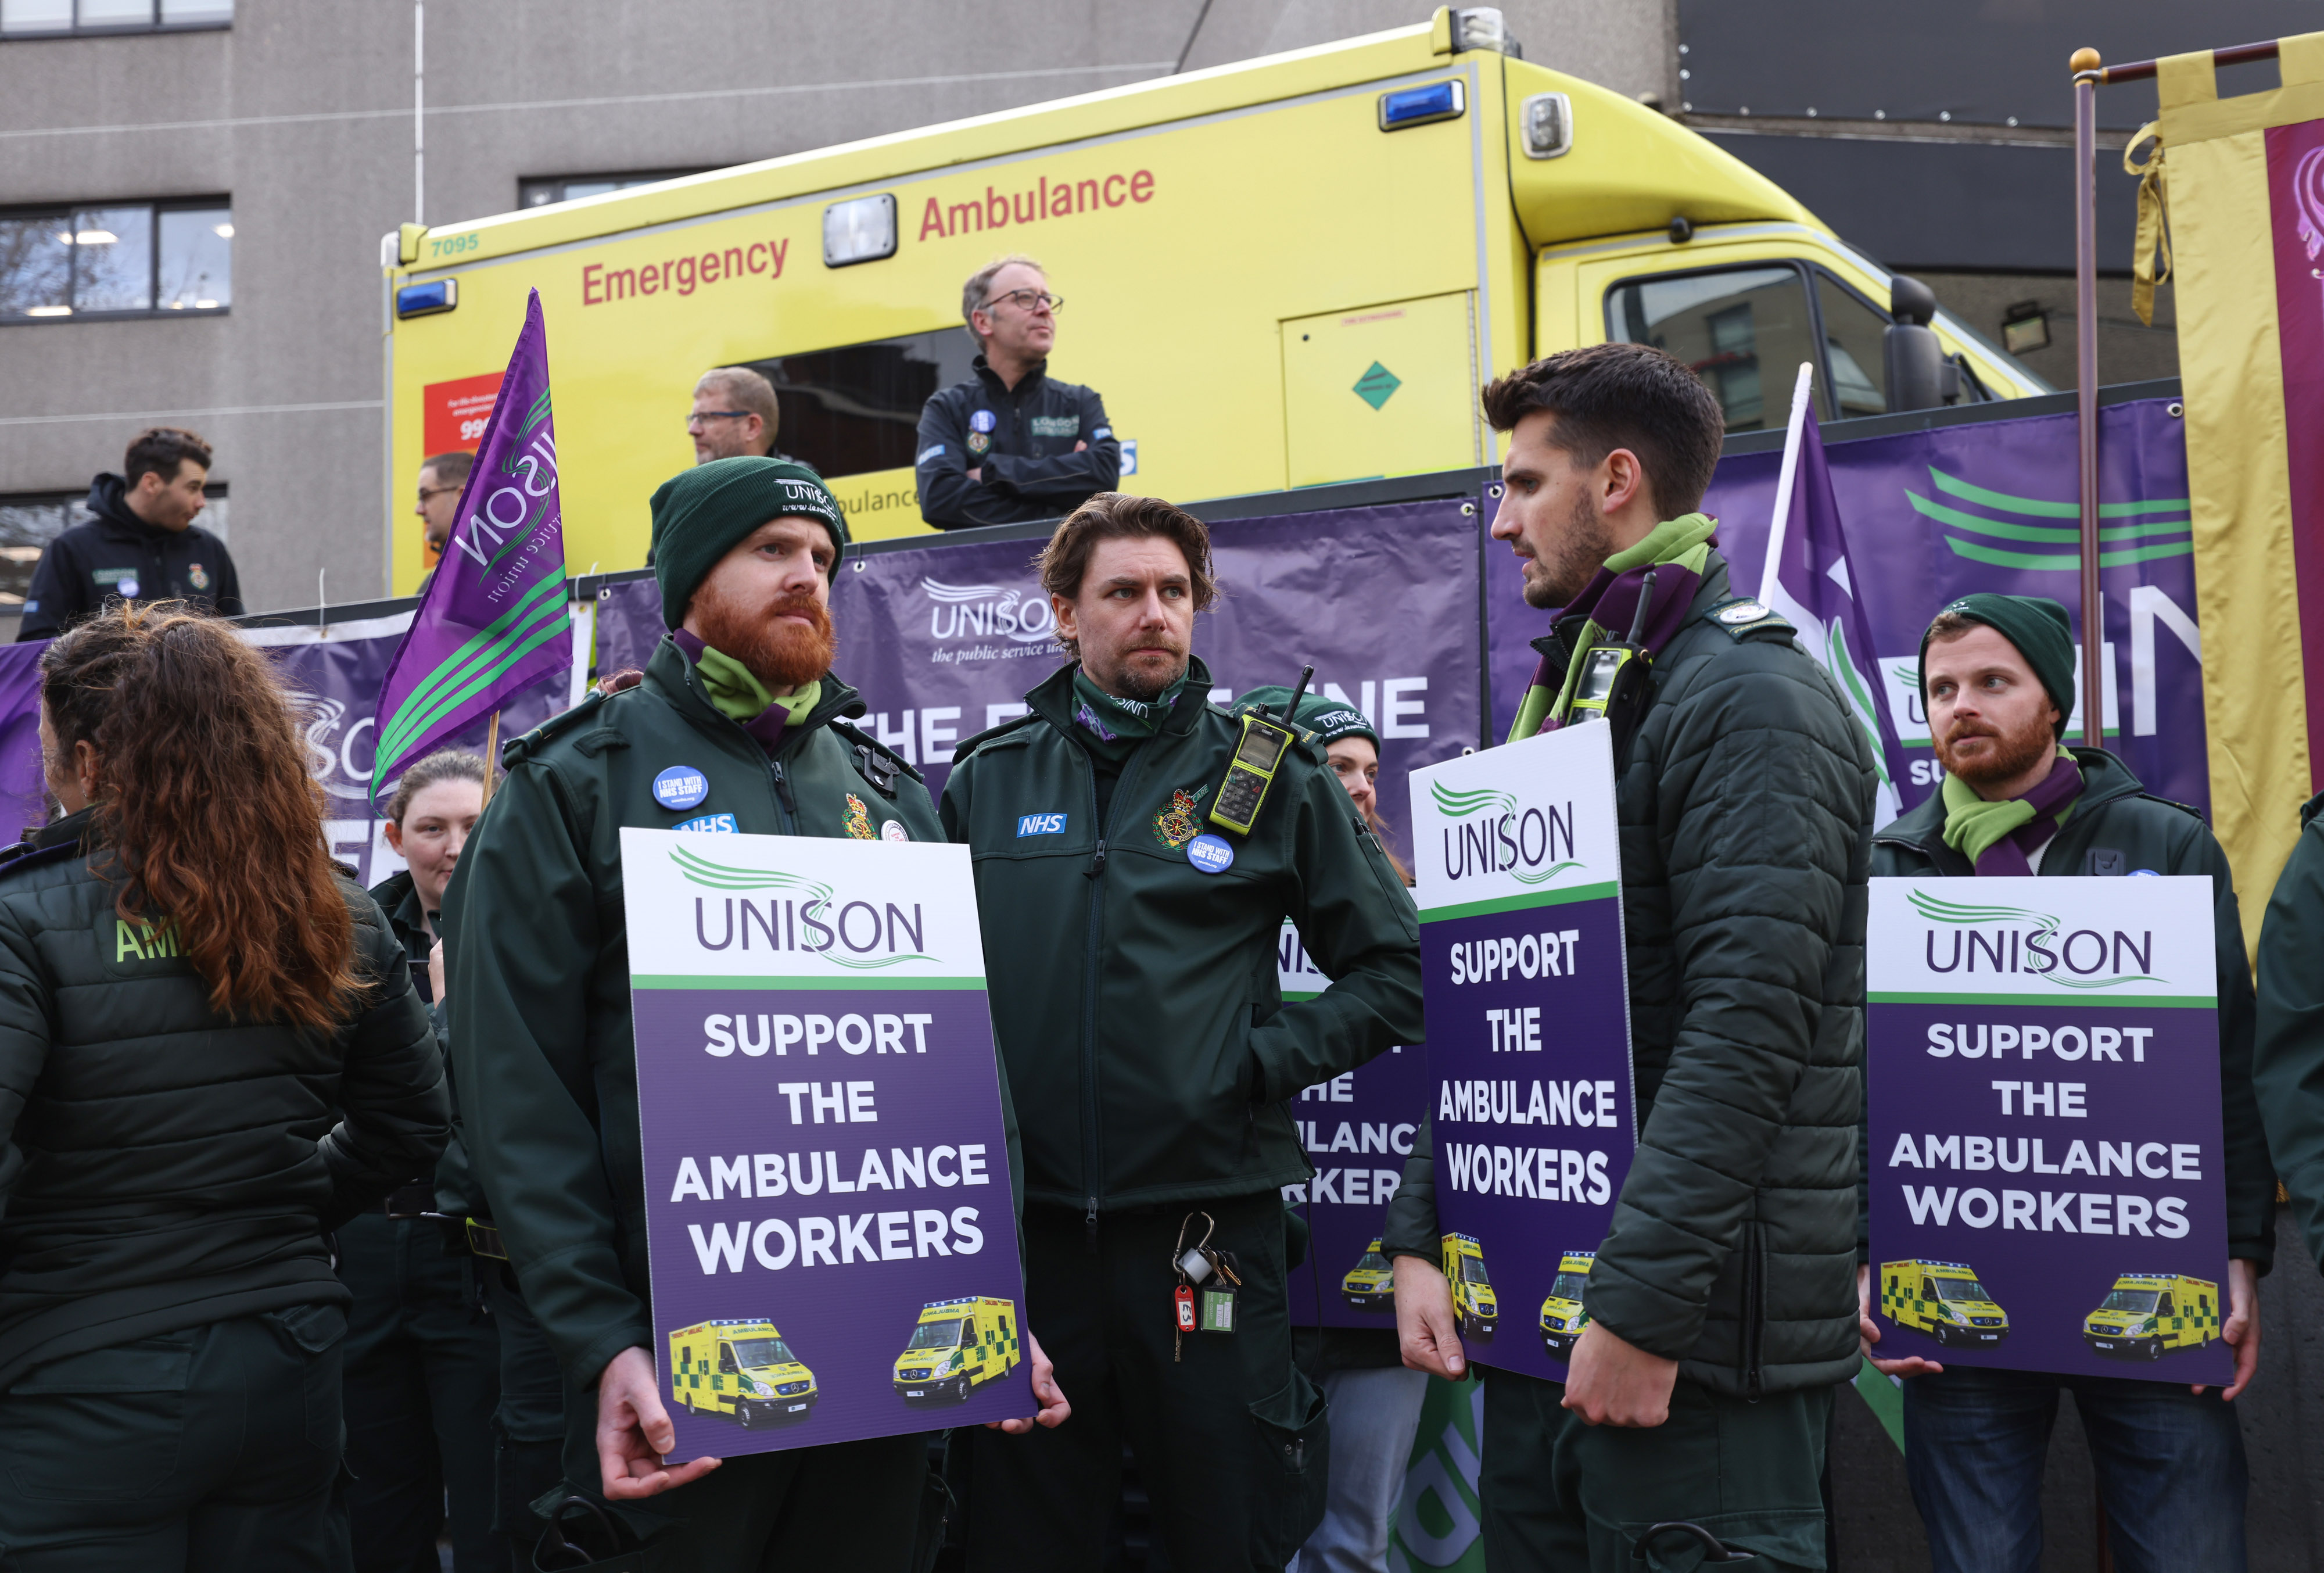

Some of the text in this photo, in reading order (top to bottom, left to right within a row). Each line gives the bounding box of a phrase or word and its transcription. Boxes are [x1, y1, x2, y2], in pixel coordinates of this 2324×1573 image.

[431, 234, 479, 257] 7095
[583, 170, 1155, 306] Emergency Ambulance
[834, 489, 920, 514] bulance
[931, 597, 1056, 639] UNISO
[931, 647, 953, 663] the
[956, 644, 999, 665] public
[1001, 643, 1043, 659] service
[658, 776, 702, 789] I STAND WITH
[659, 784, 702, 798] NHS STAFF
[1192, 786, 1209, 803] CARE
[1020, 815, 1062, 835] NHS
[1167, 814, 1190, 826] AMBULANCE
[1178, 829, 1192, 841] SERVICE
[1192, 847, 1228, 865] NHS STAFF
[1197, 842, 1214, 852] STAND
[1215, 847, 1230, 858] WITH
[1444, 801, 1573, 880] UNISON
[695, 897, 924, 953] UNISON
[1450, 929, 1580, 985] SUPPORT
[1926, 929, 2153, 975] UNISON
[704, 1013, 933, 1057] SUPPORT
[1486, 1007, 1542, 1052] THE
[1927, 1023, 2154, 1062] SUPPORT
[778, 1081, 878, 1124] THE
[1301, 1072, 1354, 1102] HE
[1439, 1080, 1618, 1128] AMBULANCE
[1992, 1080, 2088, 1117] THE
[670, 1144, 989, 1202] AMBULANCE
[1446, 1142, 1611, 1206] WORKERS
[1888, 1133, 2202, 1180] AMBULANCE
[1902, 1185, 2191, 1239] WORKERS
[687, 1206, 984, 1275] WORKERS
[733, 1327, 776, 1335] AMBULANCE
[1182, 1304, 1192, 1322] E3
